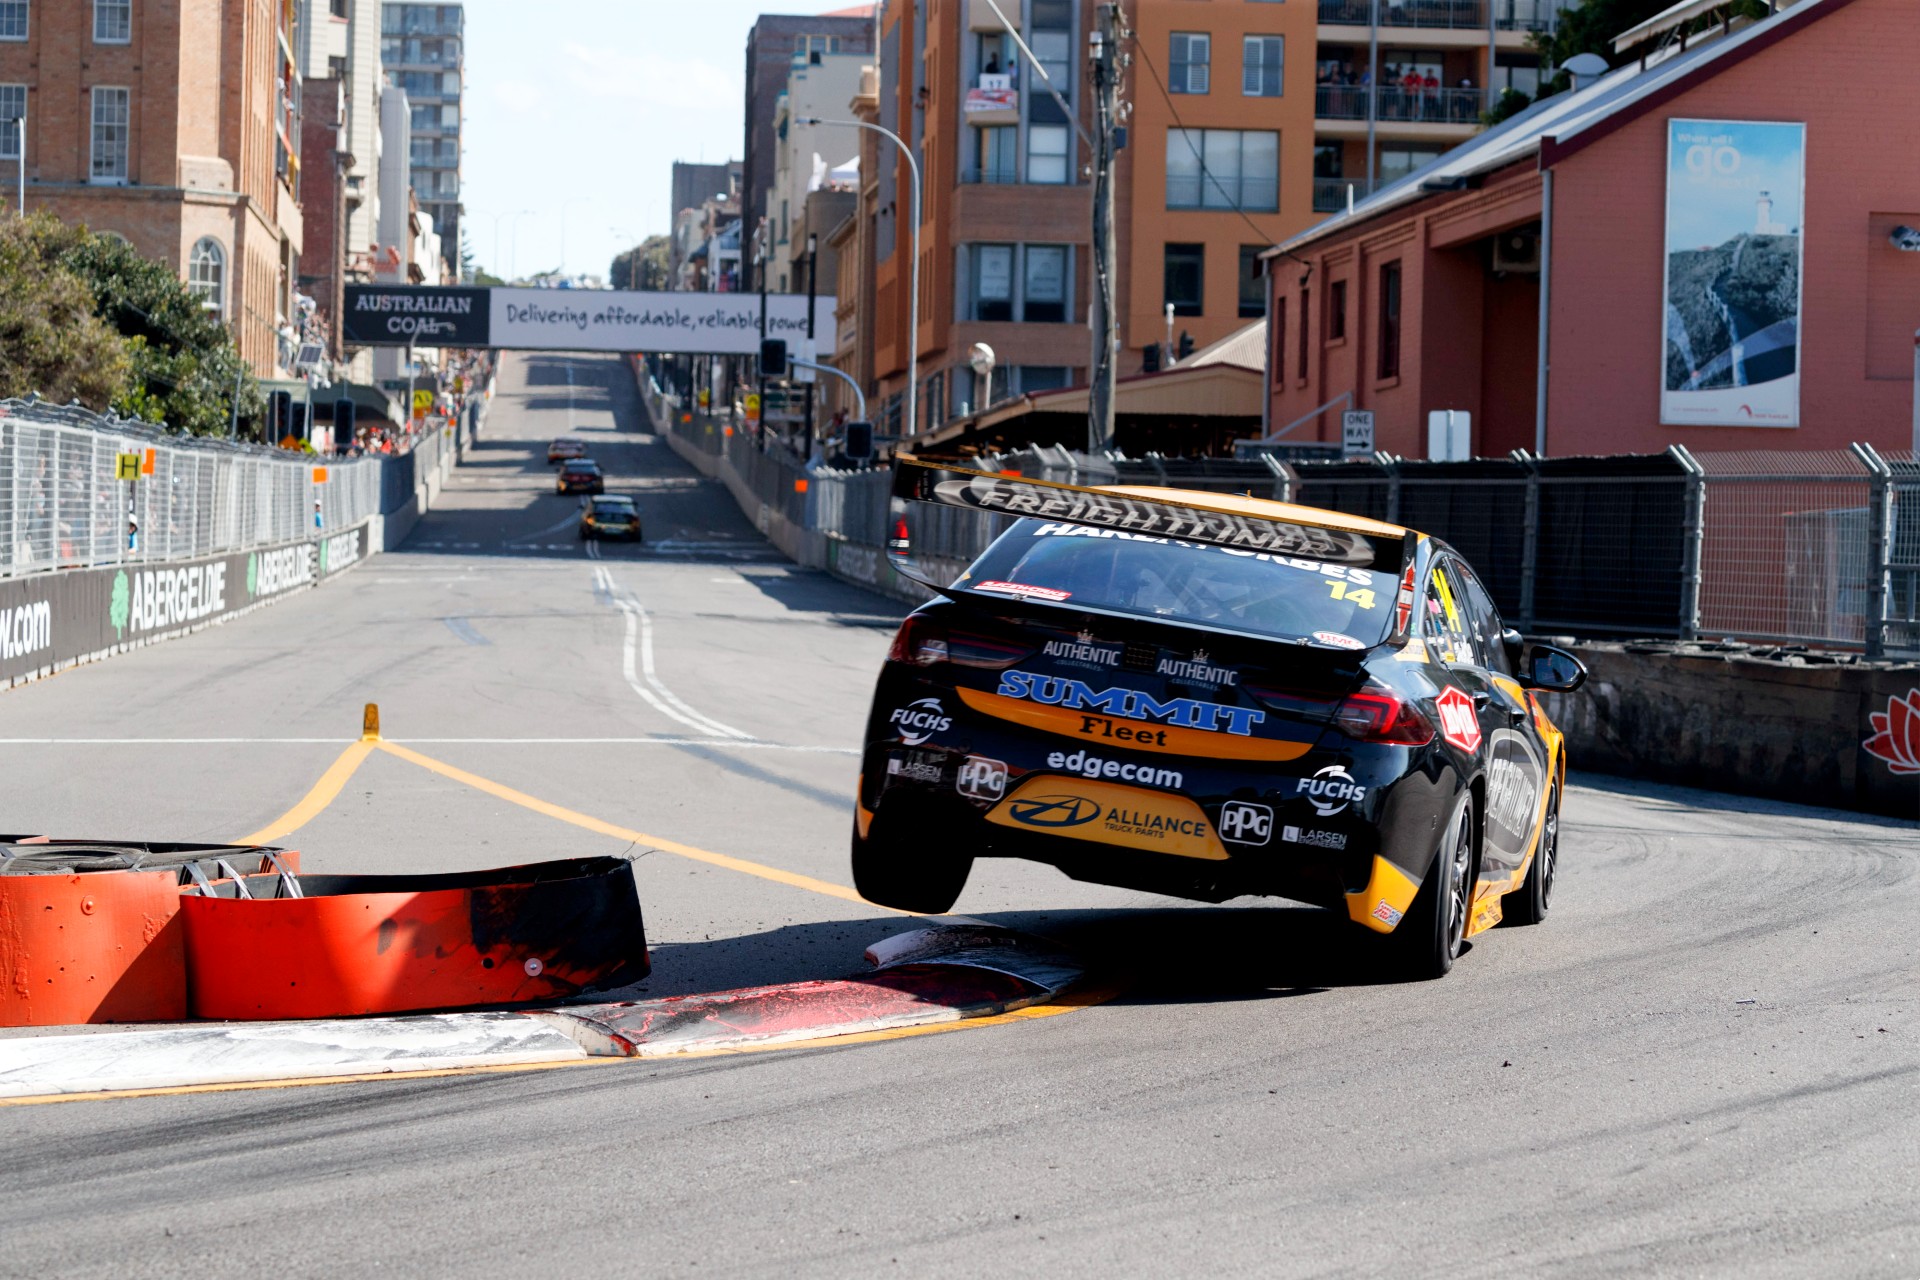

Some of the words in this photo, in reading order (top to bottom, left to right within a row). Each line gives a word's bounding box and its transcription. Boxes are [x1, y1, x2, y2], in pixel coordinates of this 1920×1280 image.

[1686, 144, 1741, 184] go
[355, 294, 472, 313] AUSTRALIAN
[507, 303, 588, 330] Delivering
[387, 316, 439, 334] COAL
[1348, 413, 1370, 425] ONE
[1347, 428, 1370, 438] WAY
[121, 456, 138, 478] H
[978, 491, 1329, 558] FREIGHTLINER
[131, 561, 227, 633] ABERGELDIE
[1325, 580, 1376, 610] 14
[1043, 641, 1121, 666] AUTHENTIC
[1157, 659, 1238, 686] AUTHENTIC
[997, 670, 1266, 736] SUMMIT
[889, 709, 953, 732] FUCHS
[1079, 716, 1168, 747] Fleet
[959, 761, 1004, 793] PPG
[1047, 751, 1183, 788] edgecam
[1296, 778, 1366, 801] FUCHS
[1104, 822, 1133, 835] TRUCK
[1135, 827, 1165, 839] PARTS
[1105, 808, 1206, 838] ALLIANCE
[1223, 807, 1269, 838] PPG
[1300, 828, 1347, 844] LARSEN
